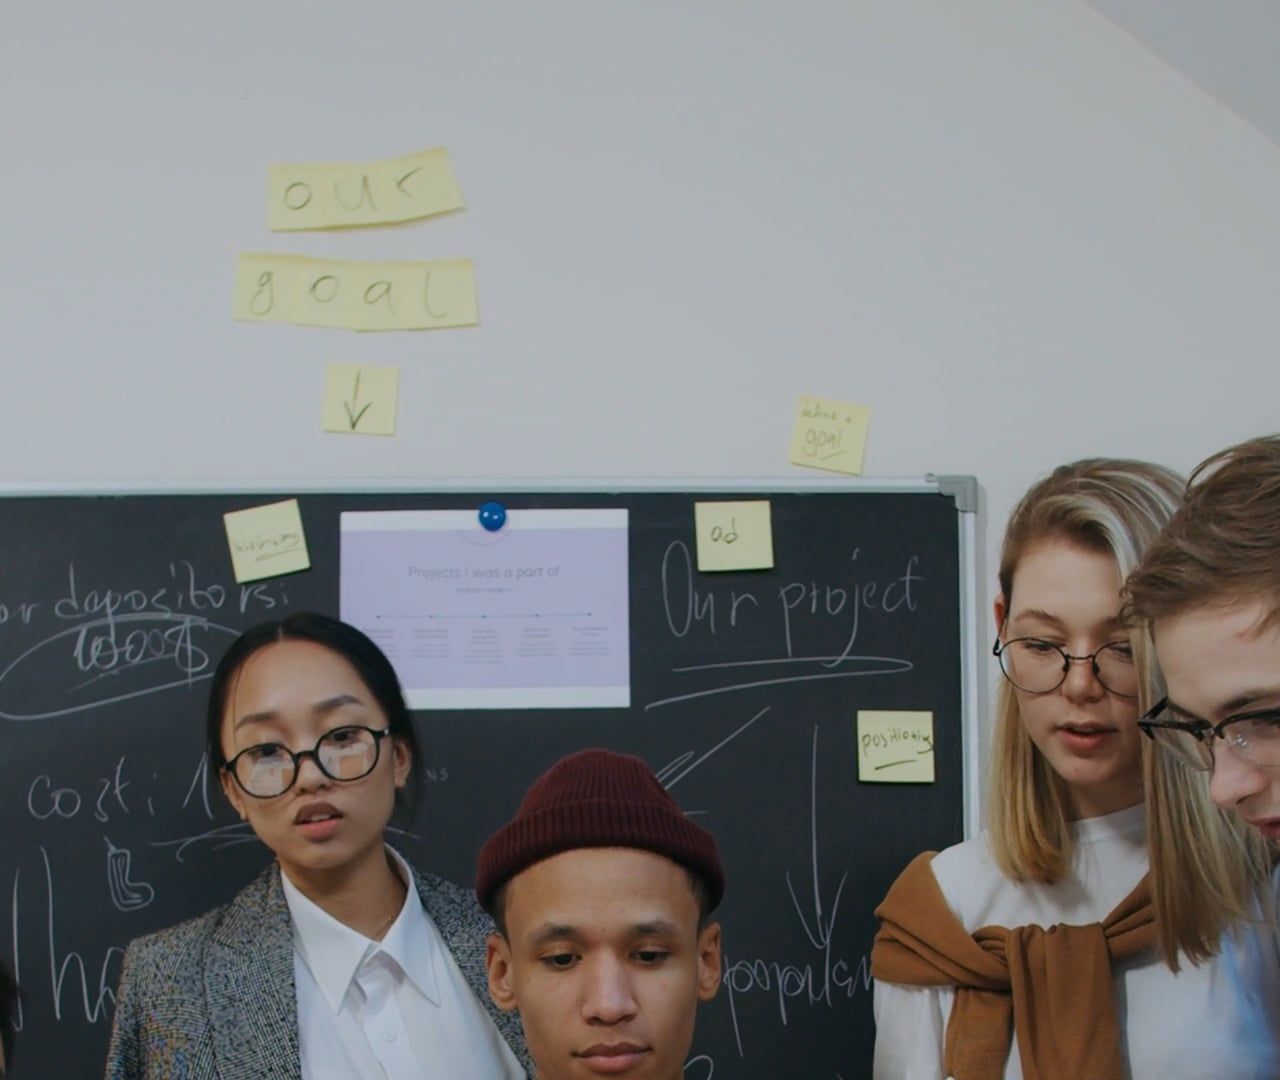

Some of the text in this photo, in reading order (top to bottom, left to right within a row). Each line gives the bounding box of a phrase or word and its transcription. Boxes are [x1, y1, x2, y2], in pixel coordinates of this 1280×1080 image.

[249, 270, 448, 319] goal
[800, 426, 843, 458] goal
[711, 517, 739, 545] ad
[408, 565, 462, 581] Projects
[472, 568, 501, 578] was
[504, 568, 513, 578] a
[516, 566, 543, 581] part
[547, 565, 560, 578] of
[661, 540, 923, 668] Our project
